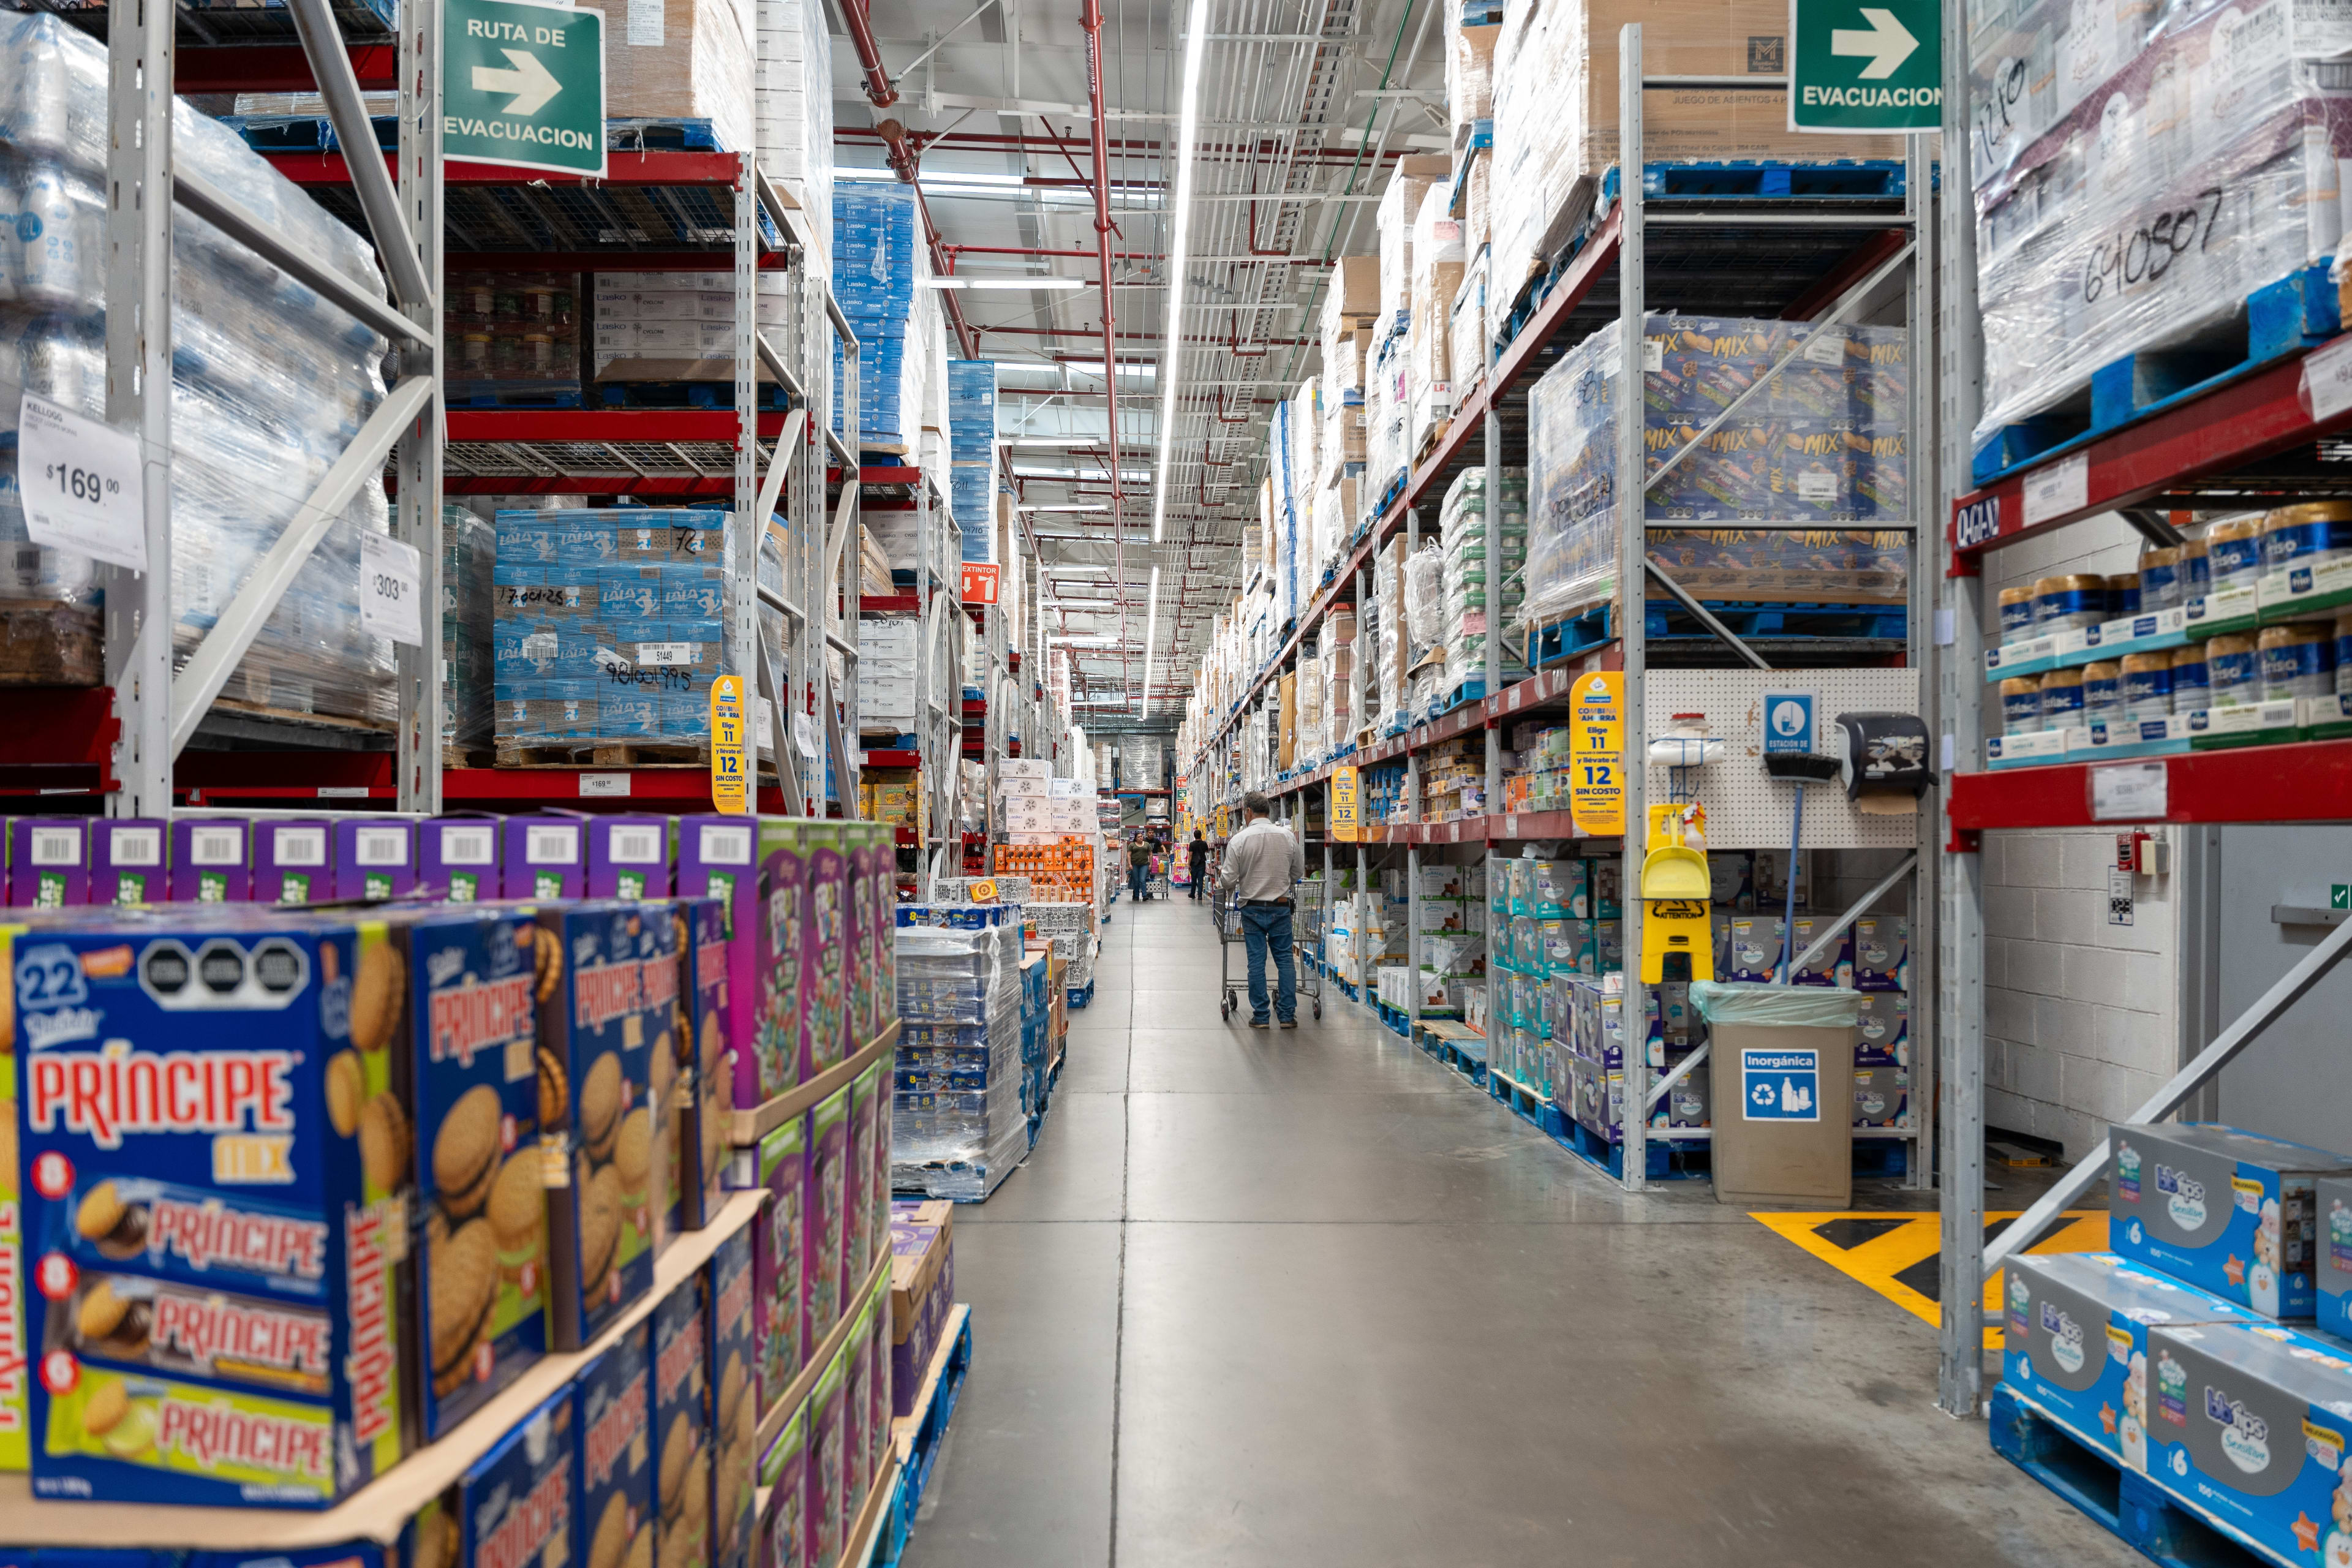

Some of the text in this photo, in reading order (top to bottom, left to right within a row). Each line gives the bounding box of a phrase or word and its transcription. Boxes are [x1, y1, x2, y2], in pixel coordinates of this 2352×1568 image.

[467, 19, 565, 47] RUTA DE
[1673, 96, 1705, 105] JUEGO
[1724, 96, 1771, 105] ASIENTOS
[444, 116, 592, 151] EVACUACION
[701, 293, 731, 302] Lasko
[1713, 335, 1749, 360] MIX
[1870, 342, 1902, 366] MIX
[1644, 426, 1677, 453] MIX
[1711, 429, 1748, 454] MIX
[1804, 432, 1839, 457] MIX
[1871, 435, 1905, 459] MIX
[500, 530, 532, 546] LALA
[561, 530, 594, 546] LALA
[962, 565, 996, 575] EXTINTOR
[603, 588, 635, 602] LALA
[666, 589, 698, 603] LALA
[657, 651, 673, 662] 51449
[603, 702, 635, 717] LALA
[724, 731, 733, 742] 11
[1591, 737, 1605, 748] 11
[1769, 739, 1798, 747] ESTACIÓN
[720, 756, 737, 773] 12
[1584, 766, 1611, 785] 12
[1338, 810, 1351, 818] 12
[909, 911, 916, 921] 8
[24, 963, 79, 1000] 22
[1741, 969, 1748, 978] 5
[1801, 969, 1808, 978] 5
[1864, 969, 1871, 978] 5
[1747, 1055, 1813, 1069] Inorgánica
[2130, 1222, 2141, 1244] 6
[2293, 1276, 2303, 1289] 6
[2021, 1357, 2030, 1379] 6
[2205, 1385, 2268, 1440] bbtips
[2225, 1433, 2266, 1461] Sensitive
[2173, 1449, 2188, 1476] 6
